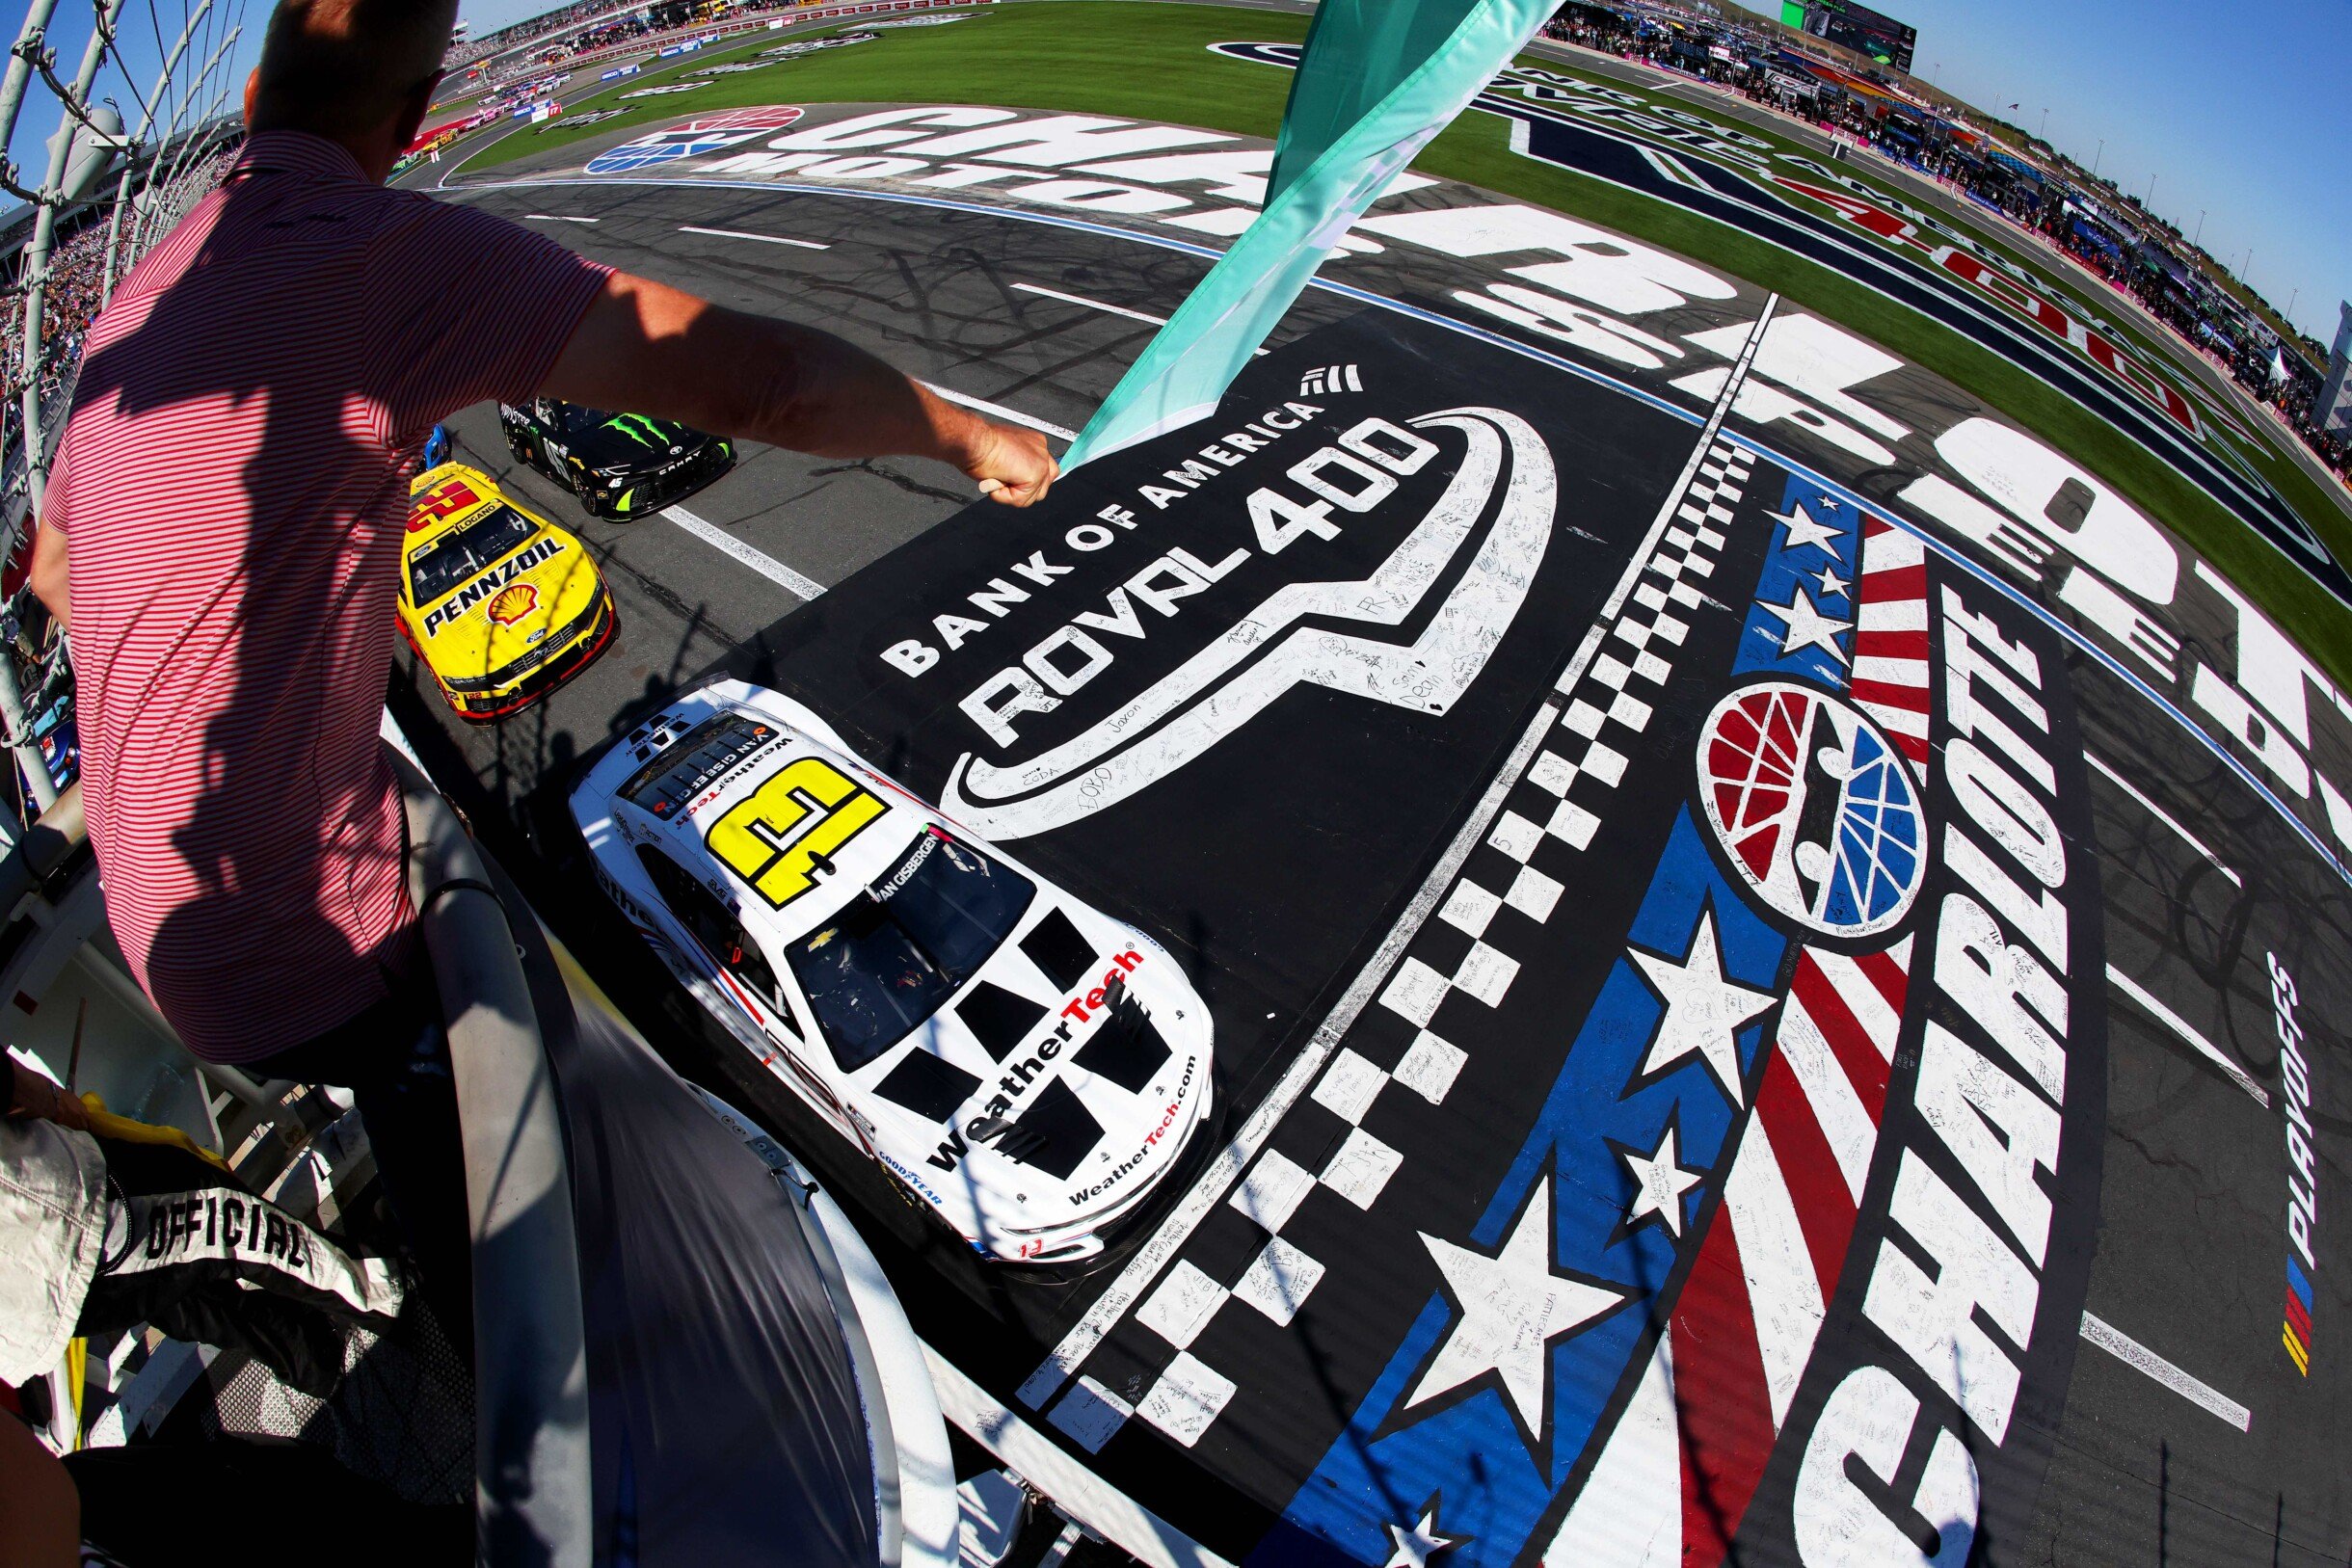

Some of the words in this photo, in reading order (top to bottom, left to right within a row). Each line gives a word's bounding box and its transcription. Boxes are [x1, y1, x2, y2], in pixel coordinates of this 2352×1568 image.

[661, 48, 679, 57] GEICO
[601, 71, 618, 80] GEICO
[514, 107, 531, 117] GEICO
[549, 106, 559, 116] 17
[1971, 194, 1987, 205] United
[1649, 104, 1776, 150] OF
[1774, 152, 2151, 363] AMERICA
[1764, 173, 2207, 442] 400
[2148, 306, 2155, 314] 48
[543, 437, 571, 484] 45
[658, 450, 702, 476] CAMRY
[608, 477, 624, 489] 45
[458, 504, 496, 531] LOGANO
[879, 549, 1076, 678] BANK
[1065, 503, 1139, 552] OF
[1136, 398, 1327, 511] AMERICA
[423, 537, 567, 638] PENNZOIL
[958, 545, 1252, 750] ROVAL
[1246, 415, 1440, 556] 400
[527, 628, 547, 644] Ford
[468, 691, 483, 700] 22
[1399, 674, 1445, 709] Dean
[1105, 704, 1142, 734] Jaxon
[736, 732, 770, 755] VAN
[663, 752, 738, 814] GISBERGEN
[675, 736, 793, 831] WeatherTech
[1077, 767, 1112, 811] BOBO
[704, 756, 895, 913] 13
[893, 832, 941, 887] GISBERGEN
[1794, 582, 2070, 1568] CHARLOTTE
[1068, 1053, 1197, 1207] WeatherTech.com
[2265, 949, 2316, 1272] PLAYOFFS
[878, 1151, 943, 1205] GOODYEAR
[147, 1196, 313, 1268] OFFICIAL
[1019, 1236, 1045, 1259] 13
